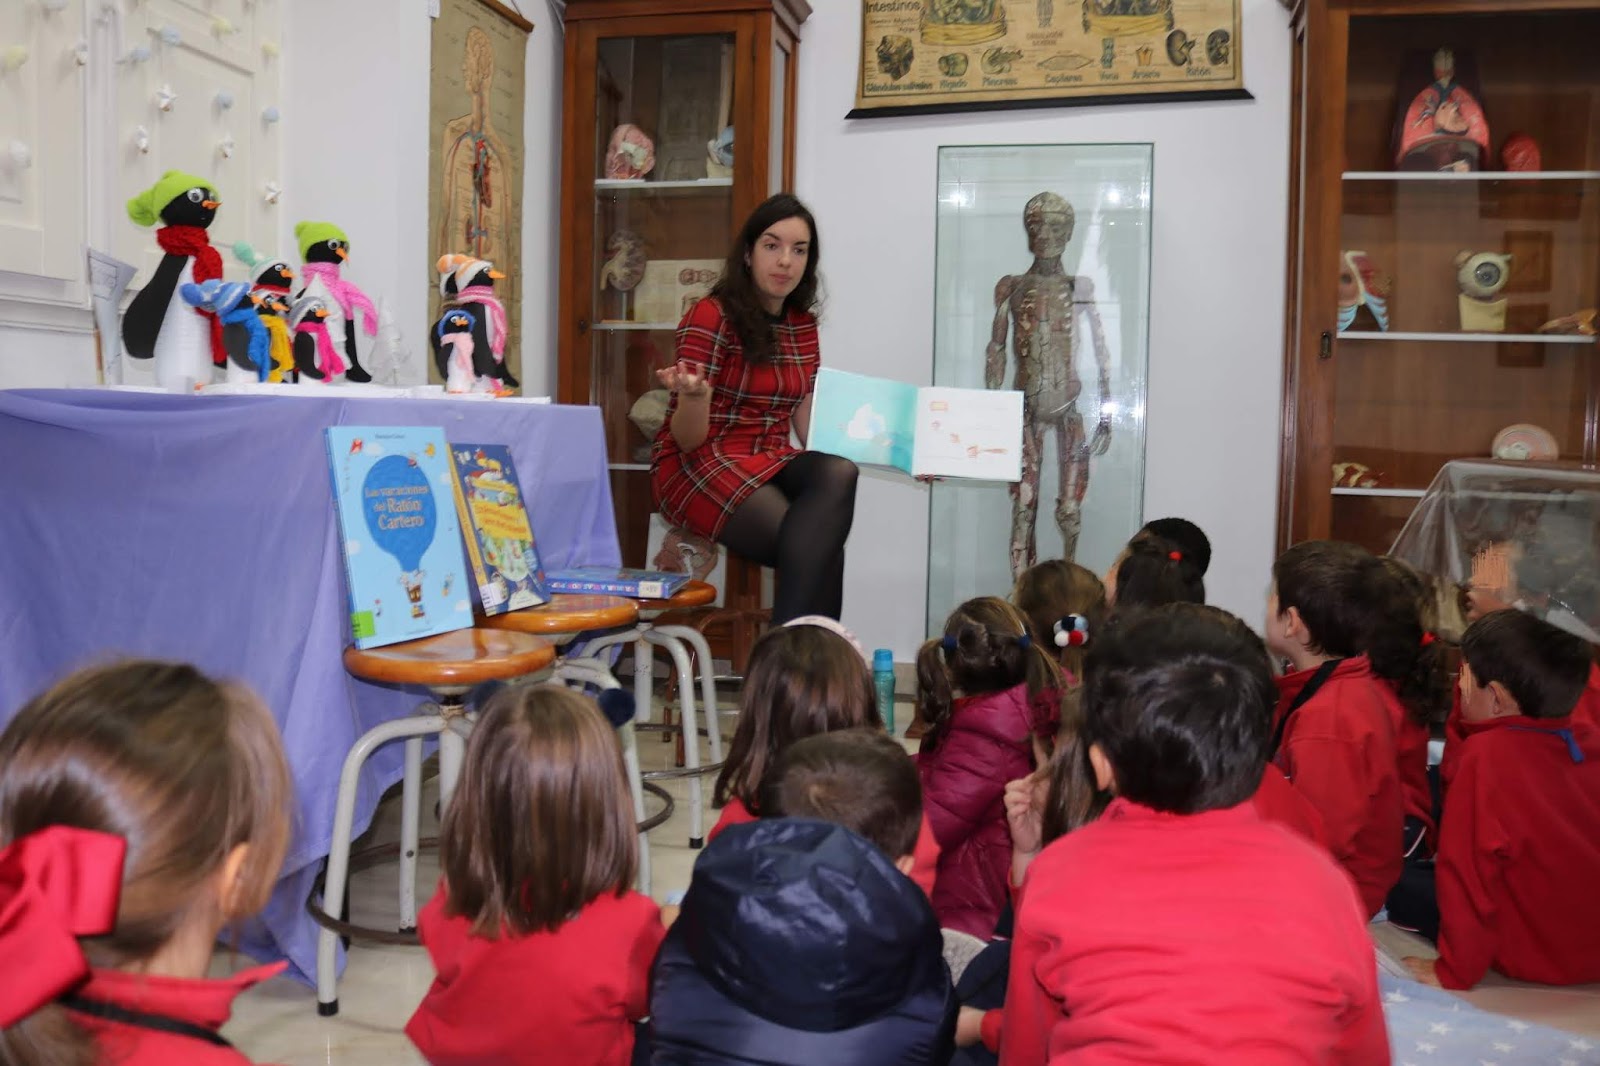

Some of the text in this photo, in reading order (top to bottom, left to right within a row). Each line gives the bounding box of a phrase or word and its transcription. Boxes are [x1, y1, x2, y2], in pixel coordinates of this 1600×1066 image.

[381, 486, 428, 496] vacaciones
[387, 497, 422, 513] Ratón
[378, 515, 425, 530] Cartero
